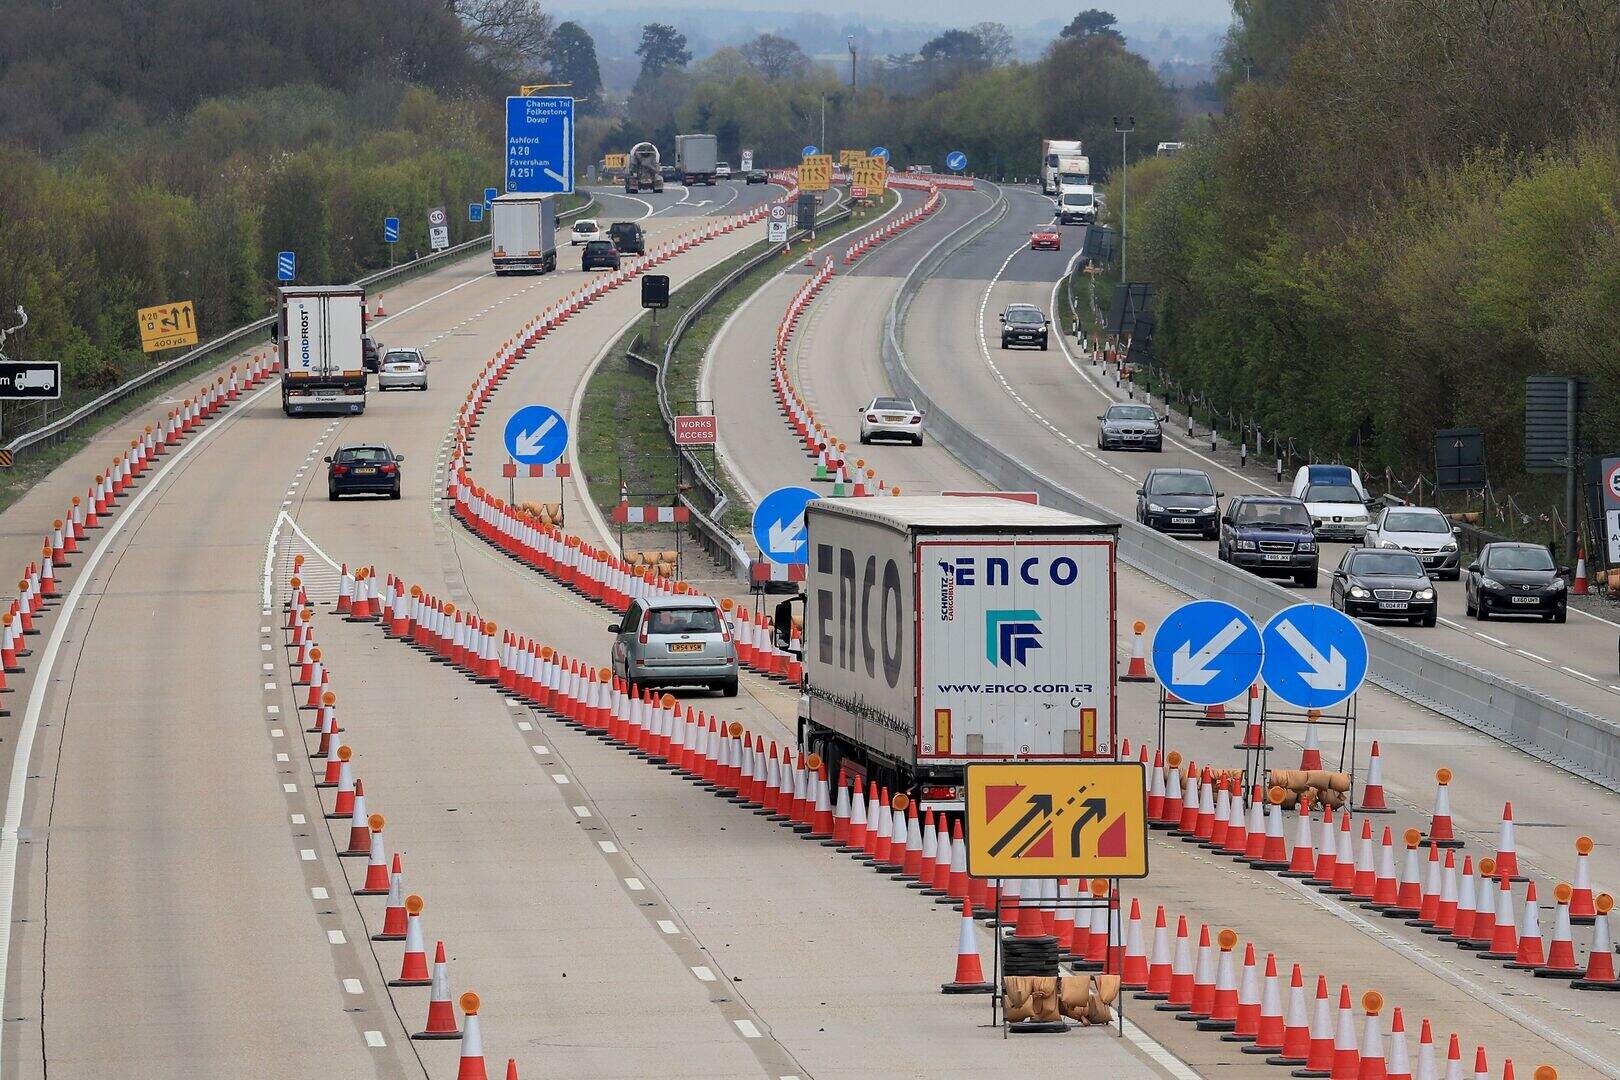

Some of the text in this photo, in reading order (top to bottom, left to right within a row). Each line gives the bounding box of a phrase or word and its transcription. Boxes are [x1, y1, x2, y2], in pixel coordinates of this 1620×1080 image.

[510, 168, 534, 178] A251
[142, 312, 158, 322] A20
[301, 310, 310, 368] NORDFROST
